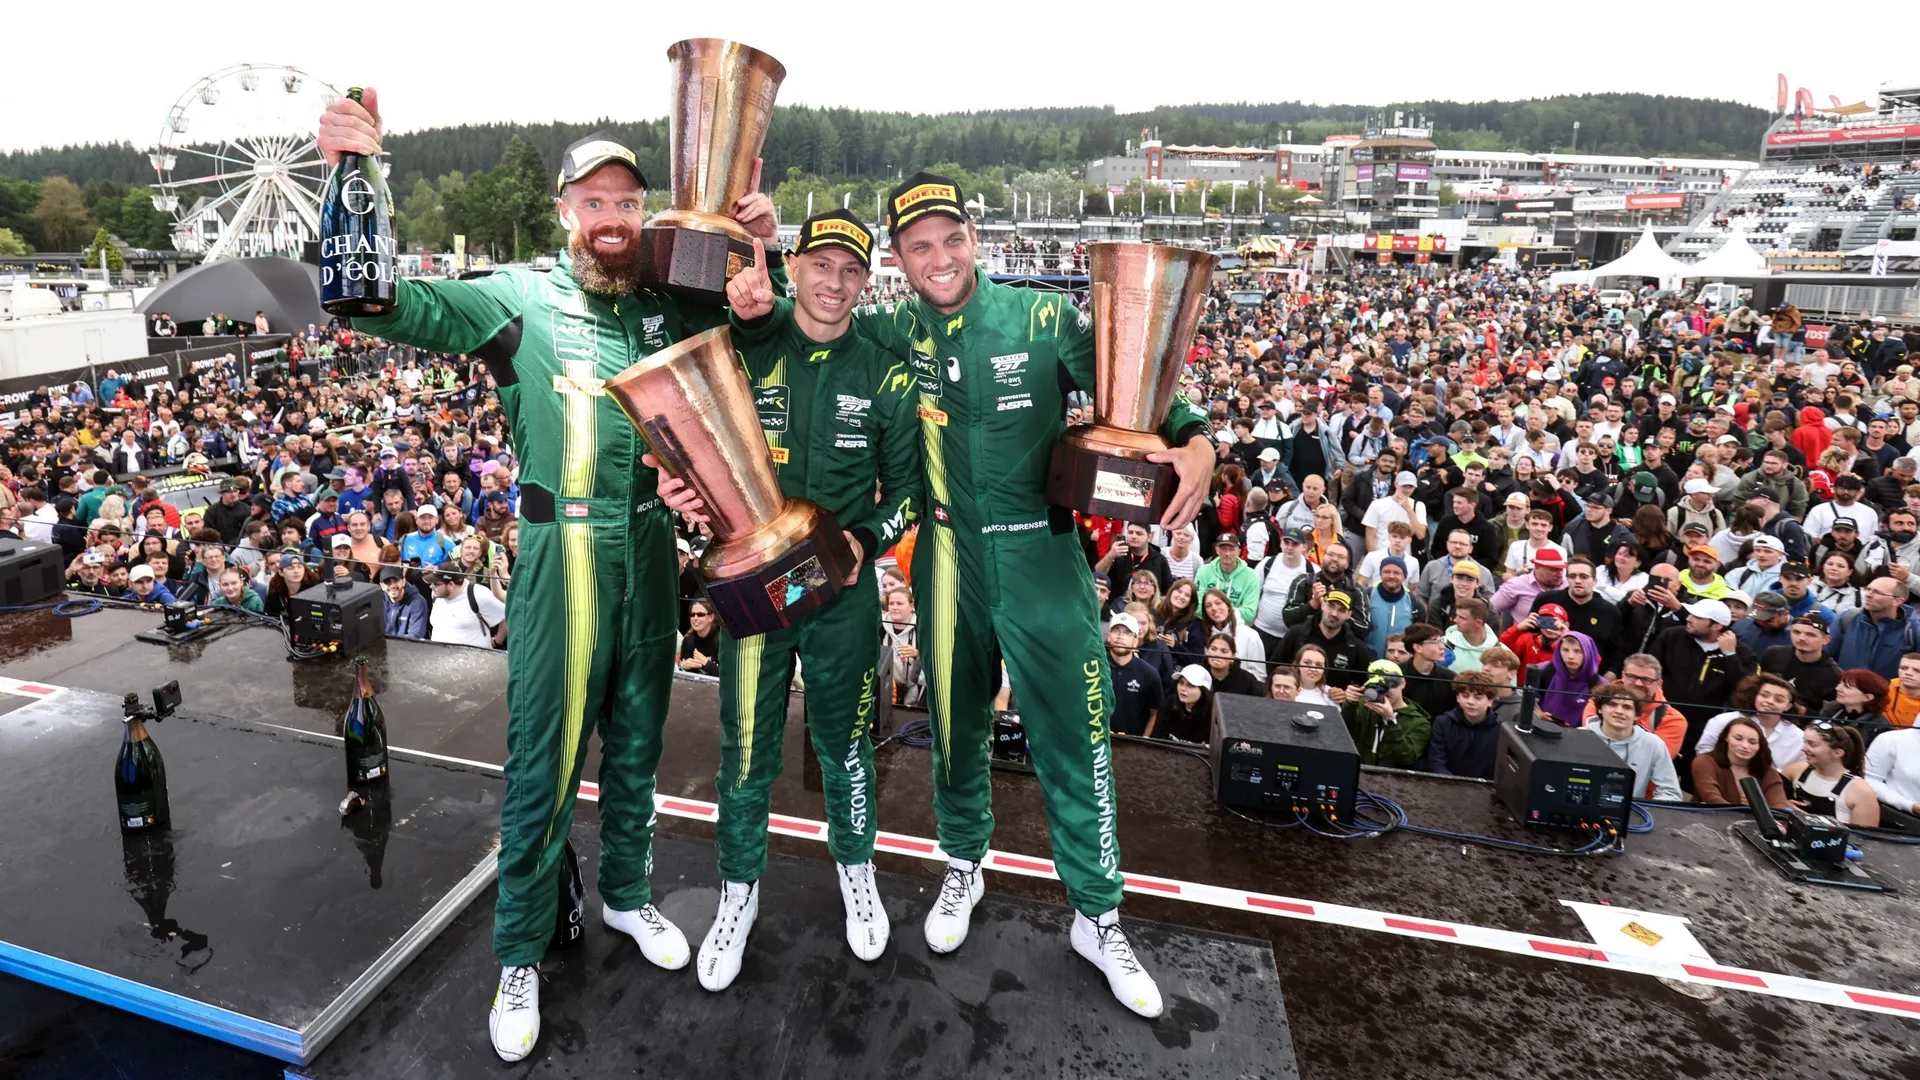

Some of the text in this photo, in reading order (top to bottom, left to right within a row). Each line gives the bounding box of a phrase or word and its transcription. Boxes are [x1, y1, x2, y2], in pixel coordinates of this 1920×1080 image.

[1774, 132, 1830, 142] CROWDSTRIKE
[1845, 127, 1905, 137] CROWDSTRIKE
[898, 186, 952, 208] PIRELLI
[815, 222, 867, 244] PIRELLI
[321, 234, 398, 259] CHANT
[1842, 258, 1920, 272] sprk
[991, 354, 1028, 363] FANATEC
[911, 359, 936, 378] AMR
[755, 396, 785, 409] AMR
[156, 479, 222, 494] ANATEC
[982, 519, 1048, 534] MARCO SØRENSEN
[850, 667, 875, 740] RACING
[1083, 659, 1105, 745] RACING
